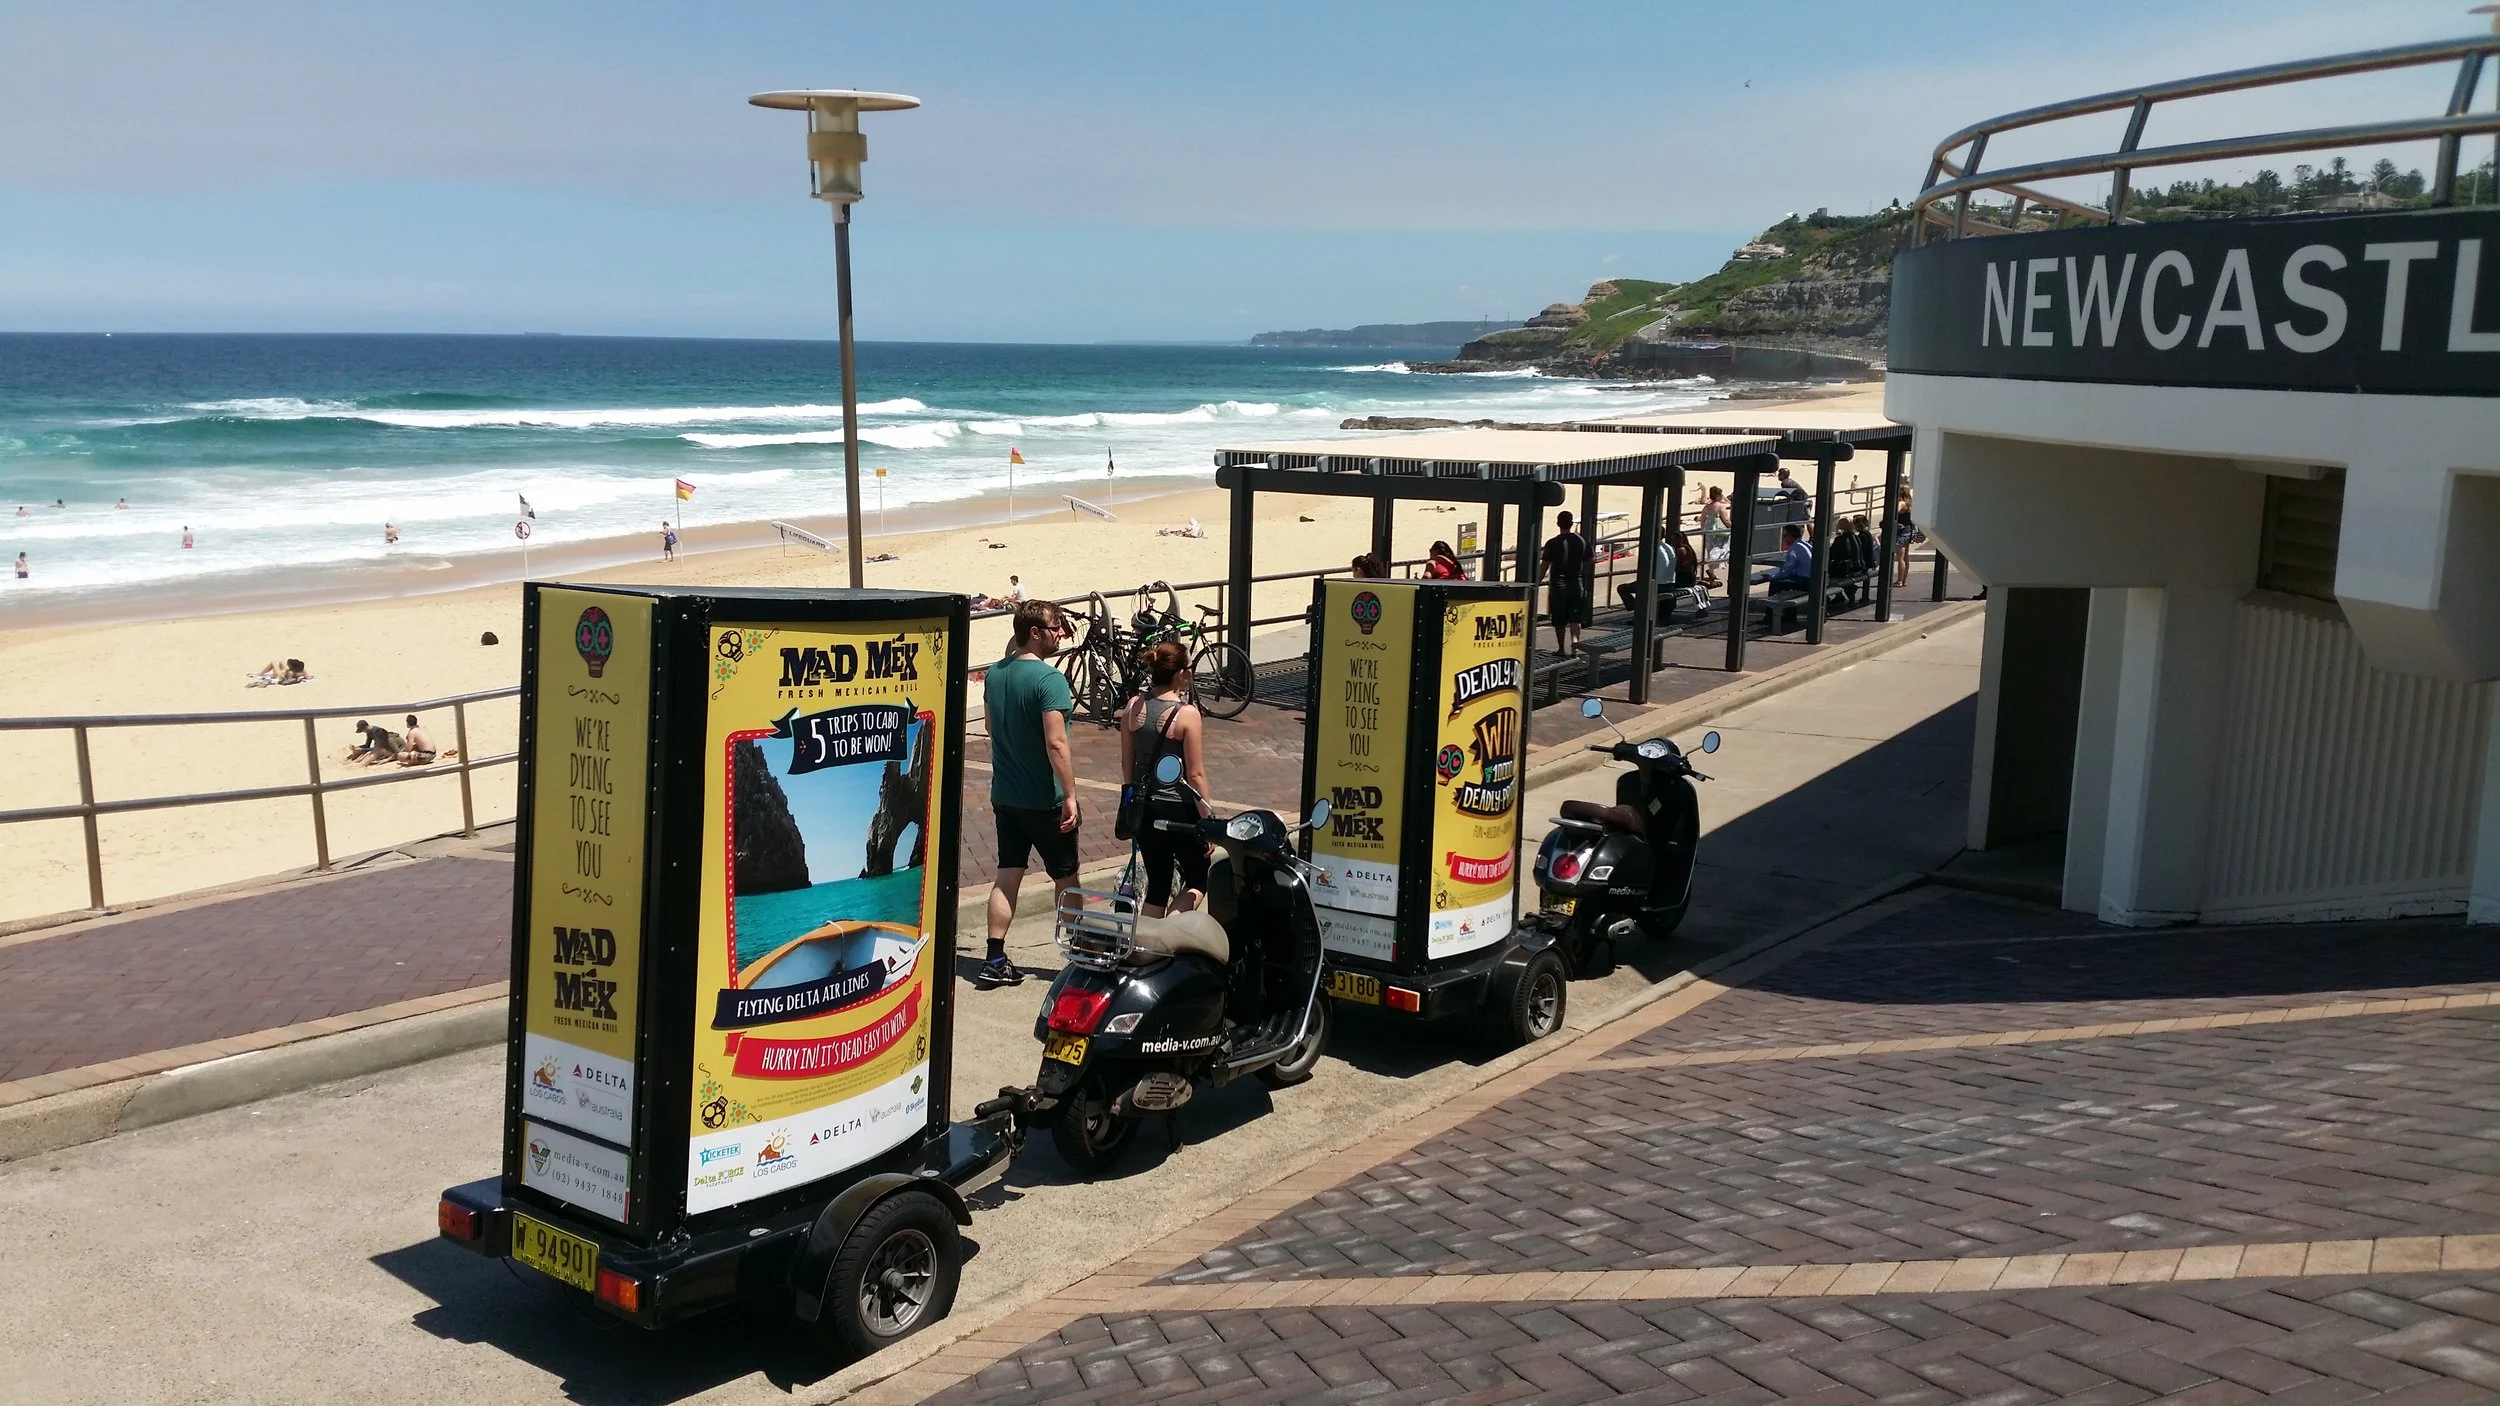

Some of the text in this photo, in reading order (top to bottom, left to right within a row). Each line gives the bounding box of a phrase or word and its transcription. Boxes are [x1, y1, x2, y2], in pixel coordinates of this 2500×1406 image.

[1982, 239, 2500, 354] NEWCASTL
[789, 530, 826, 549] LIFEGUARD
[1474, 614, 1507, 640] MAD
[779, 644, 858, 686] MAD
[1350, 658, 1378, 679] WE'RE
[778, 684, 918, 699] FRESH MEXICAN GRILL
[1345, 680, 1379, 705] DYING
[1345, 706, 1378, 730] TO SEE
[575, 716, 610, 752] WE'RE
[810, 711, 898, 763] 5 TRIPS TO CABO
[832, 731, 893, 758] TO BE WON!
[1349, 733, 1370, 756] YOU
[570, 753, 612, 795] DYING
[1331, 786, 1382, 809] MAD
[570, 795, 610, 836] TO SEE
[576, 840, 601, 879] YOU
[1356, 870, 1392, 883] DELTA
[553, 926, 616, 967] MAD
[737, 971, 870, 1018] FLYING DELTA AIR LINES
[554, 1016, 571, 1026] FRESH
[574, 1018, 599, 1030] MEXICAN
[761, 1005, 907, 1071] HURRY IN! IT'S DEAD EASY TO WIN!
[1141, 1034, 1221, 1054] media-v.com.au
[586, 1067, 627, 1091] DELTA
[529, 1088, 542, 1098] LOS
[543, 1091, 566, 1105] CABOS
[591, 1103, 623, 1120] australia
[823, 1118, 861, 1140] DELTA
[702, 1146, 739, 1160] TICKETEK
[553, 1151, 625, 1183] media-v.com.au
[753, 1161, 797, 1178] LOS CABOS
[552, 1169, 623, 1204] (02) 9437 1848
[516, 1219, 592, 1279] W 94901
